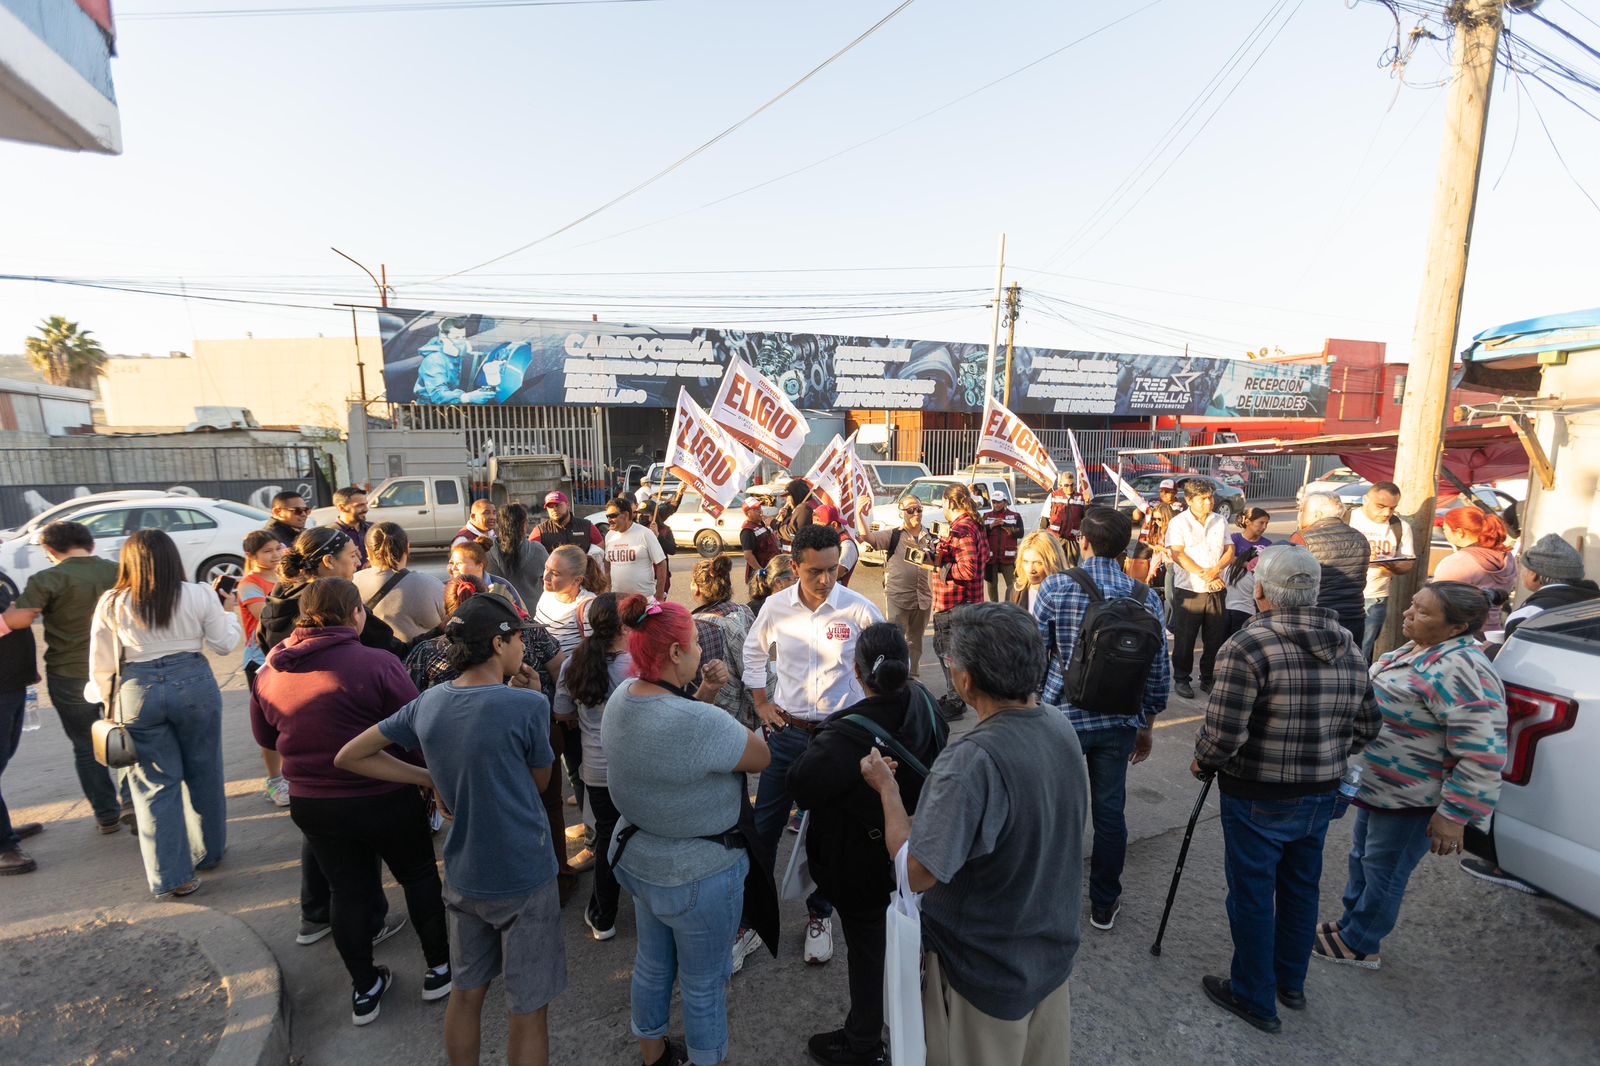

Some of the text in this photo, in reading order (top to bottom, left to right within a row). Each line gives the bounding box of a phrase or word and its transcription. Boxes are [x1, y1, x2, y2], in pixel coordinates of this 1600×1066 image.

[1135, 377, 1168, 391] TRES
[1244, 376, 1304, 393] RECEPCIÓN
[1130, 391, 1190, 404] ESTRELLAS
[1237, 395, 1306, 410] DE UNIDADES
[724, 372, 798, 440] ELIGIO
[608, 549, 636, 562] ELIGIO
